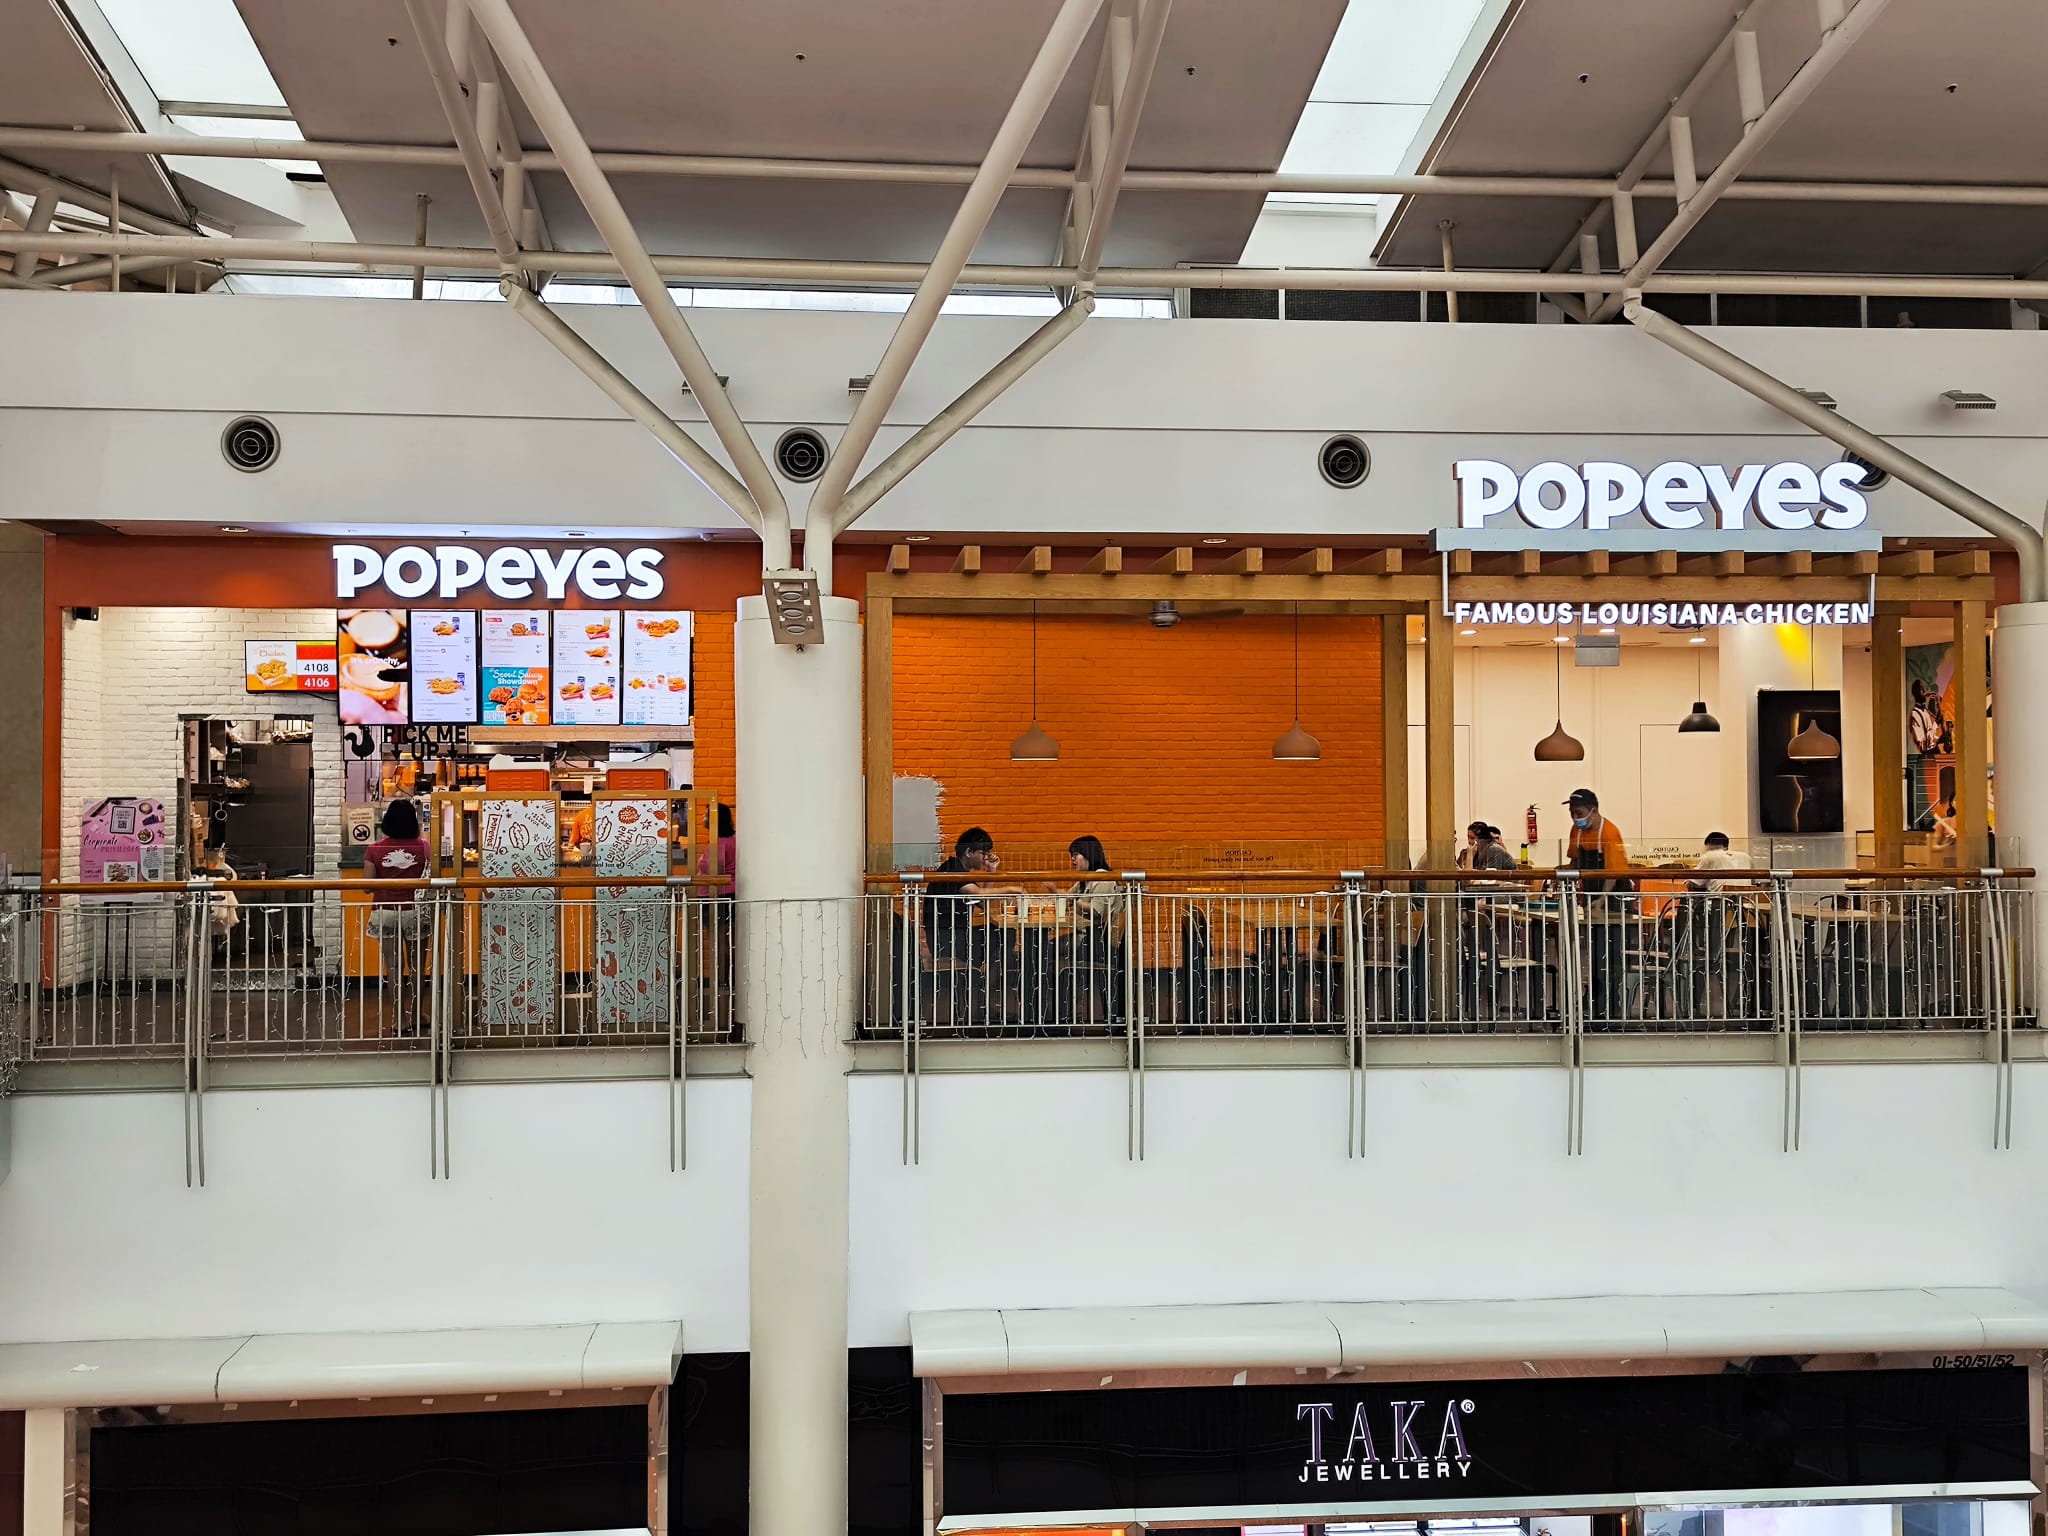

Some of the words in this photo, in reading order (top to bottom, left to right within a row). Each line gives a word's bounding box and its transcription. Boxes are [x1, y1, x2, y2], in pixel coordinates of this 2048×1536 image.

[1455, 601, 1573, 625] FAMOUS
[1583, 601, 1738, 625] LOUISIANA
[1741, 602, 1871, 625] CHICKEN
[304, 663, 329, 672] 4108
[304, 678, 330, 687] 4106
[437, 725, 467, 743] ME
[411, 742, 440, 760] UP
[1932, 1354, 2015, 1368] 01-50/51/52
[1298, 1462, 1472, 1483] JEWELLERY
